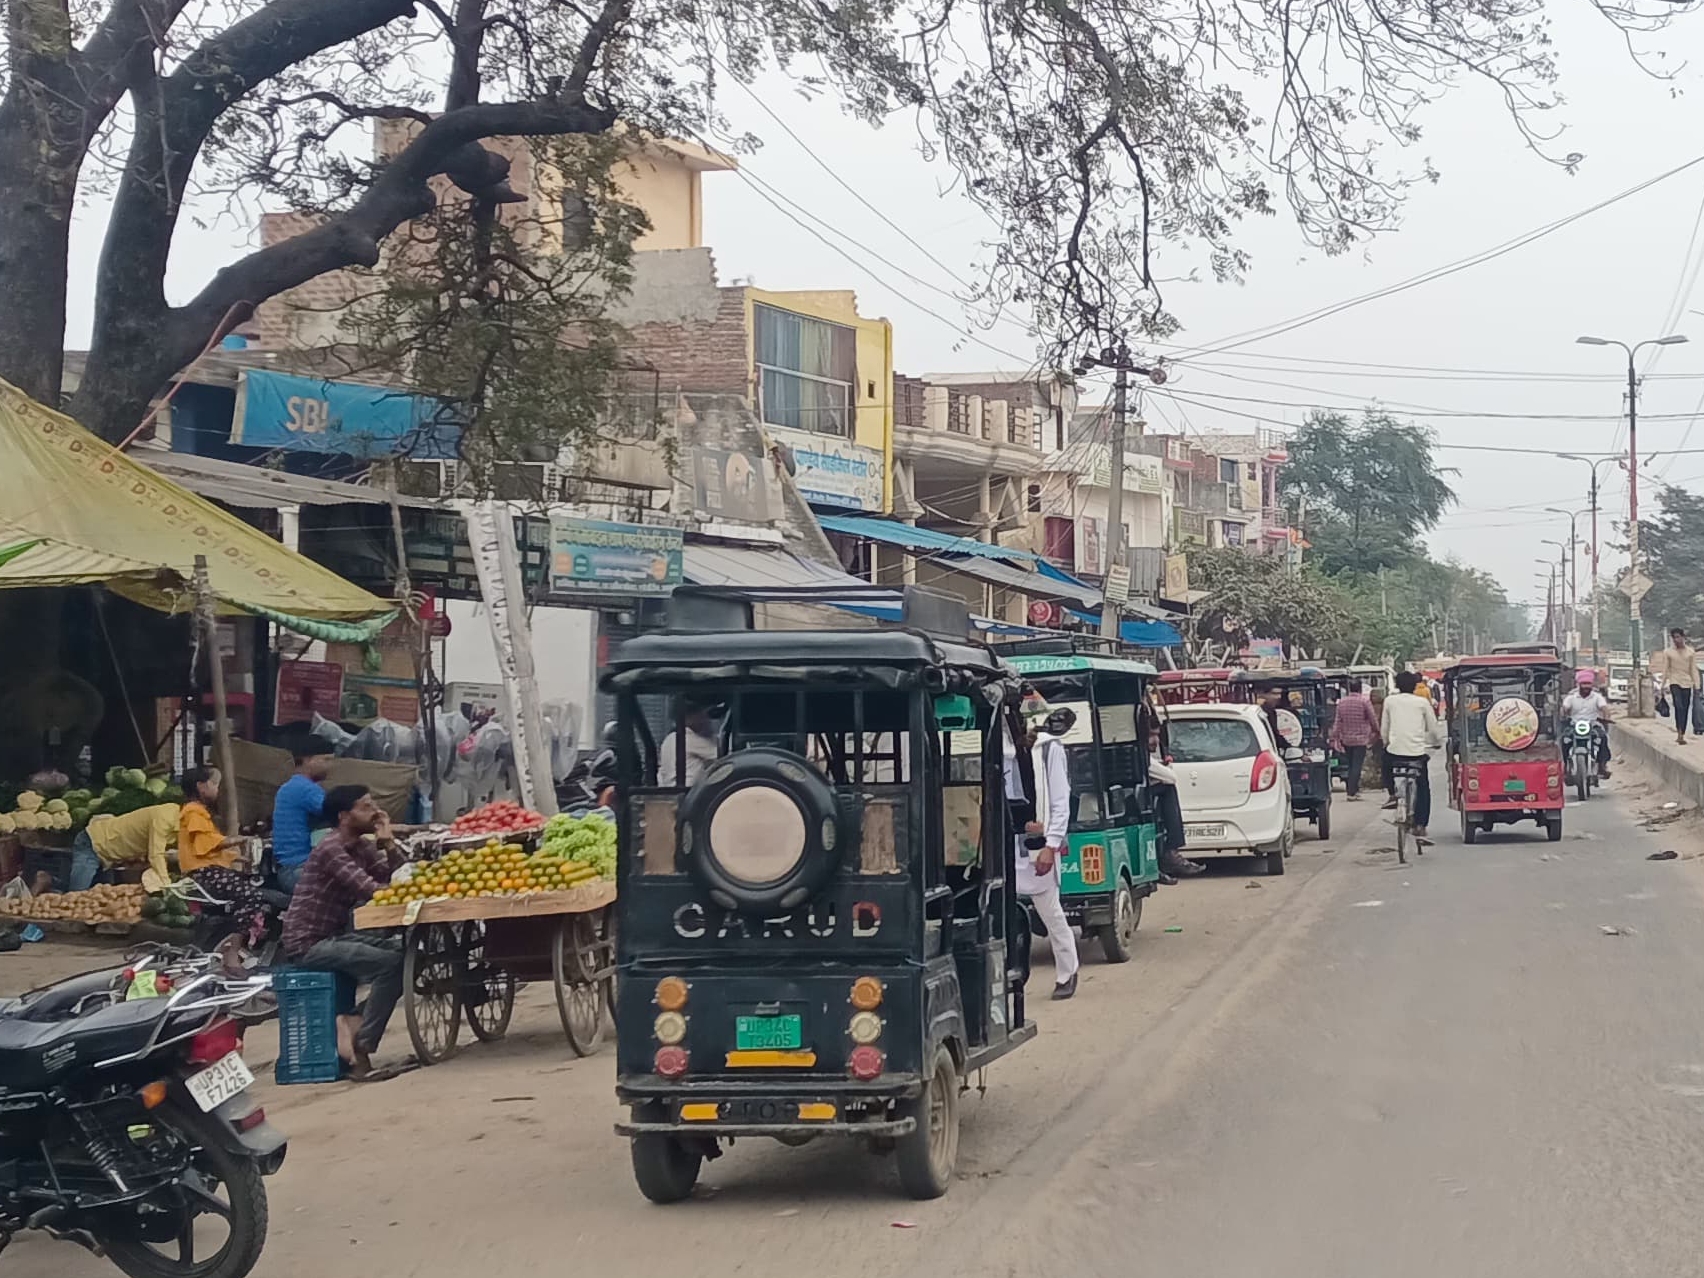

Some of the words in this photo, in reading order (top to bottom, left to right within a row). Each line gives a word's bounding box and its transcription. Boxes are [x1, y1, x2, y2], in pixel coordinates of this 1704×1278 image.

[285, 396, 329, 434] SBI
[198, 1058, 238, 1089] UP31C
[207, 1072, 247, 1104] F7426
